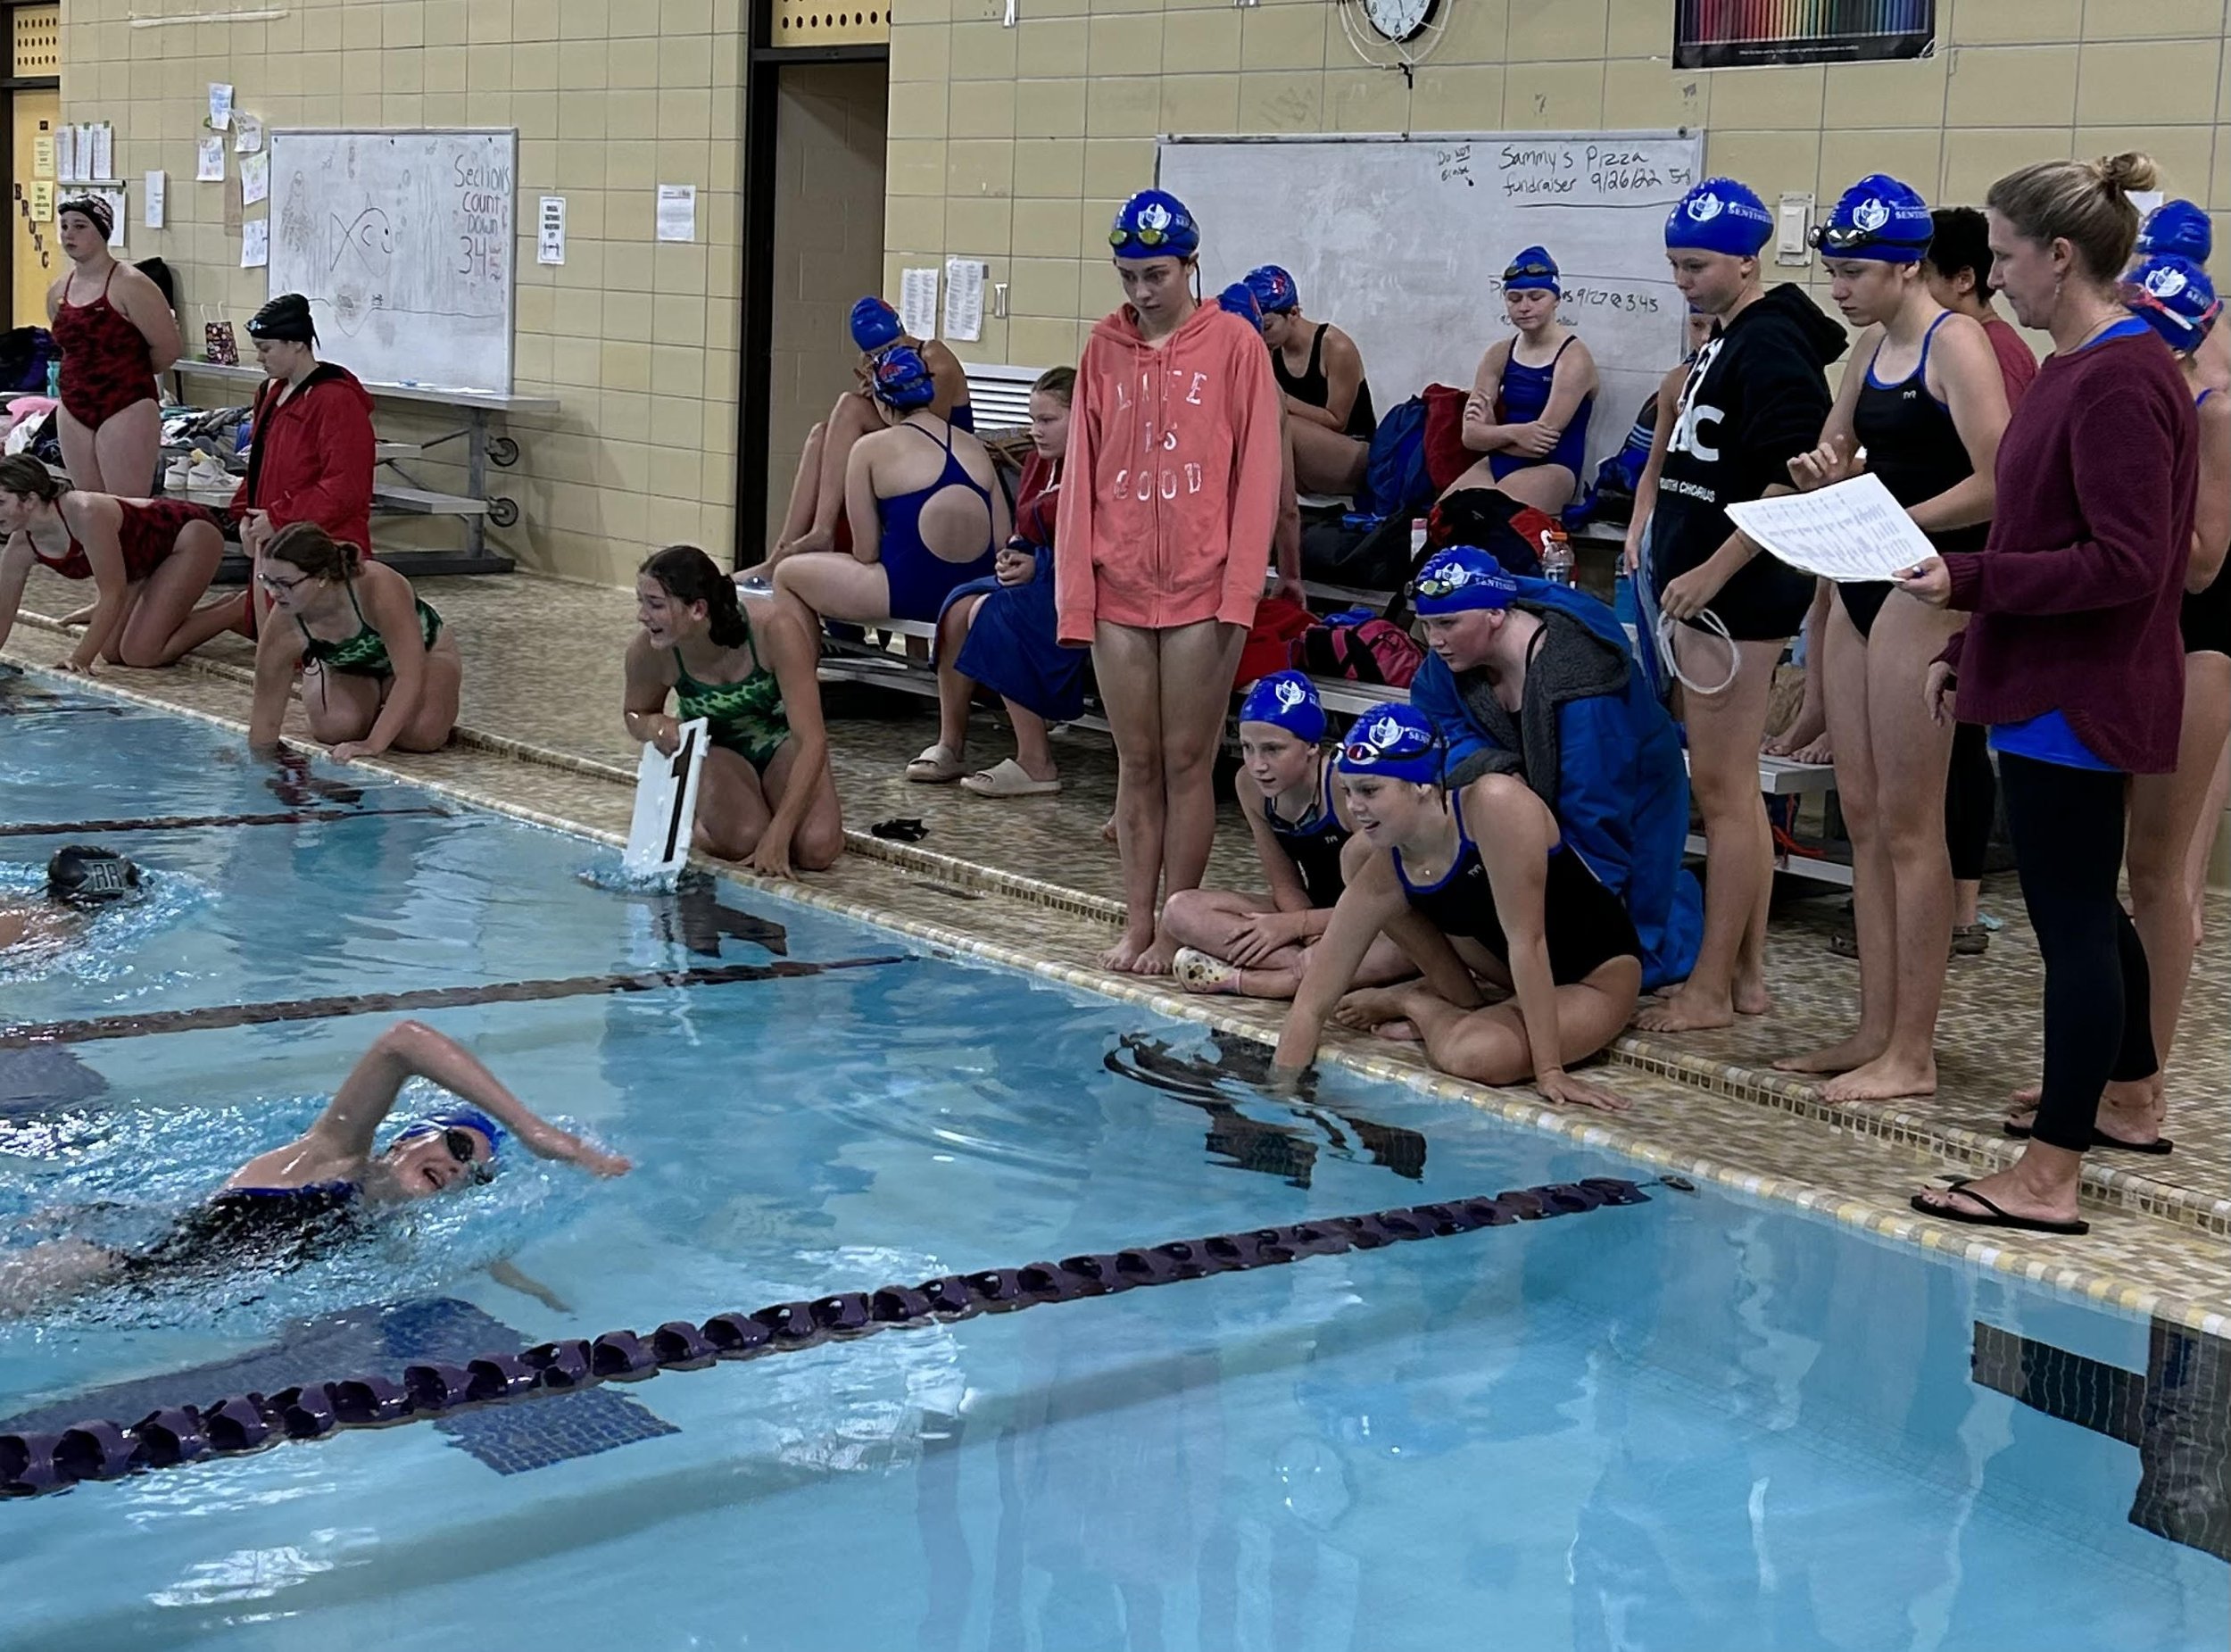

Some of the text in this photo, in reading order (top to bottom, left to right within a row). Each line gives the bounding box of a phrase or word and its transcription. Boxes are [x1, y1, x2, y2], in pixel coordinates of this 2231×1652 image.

[1394, 20, 1401, 34] 6
[454, 154, 511, 195] Sections
[1498, 145, 1649, 175] Sammy's Pizza
[1503, 171, 1577, 197] fundraiser
[1591, 168, 1663, 195] 9/26/22
[458, 235, 487, 278] 34
[1116, 369, 1207, 411] LIFE
[1144, 421, 1178, 454] IS
[1112, 461, 1203, 502] GOOD
